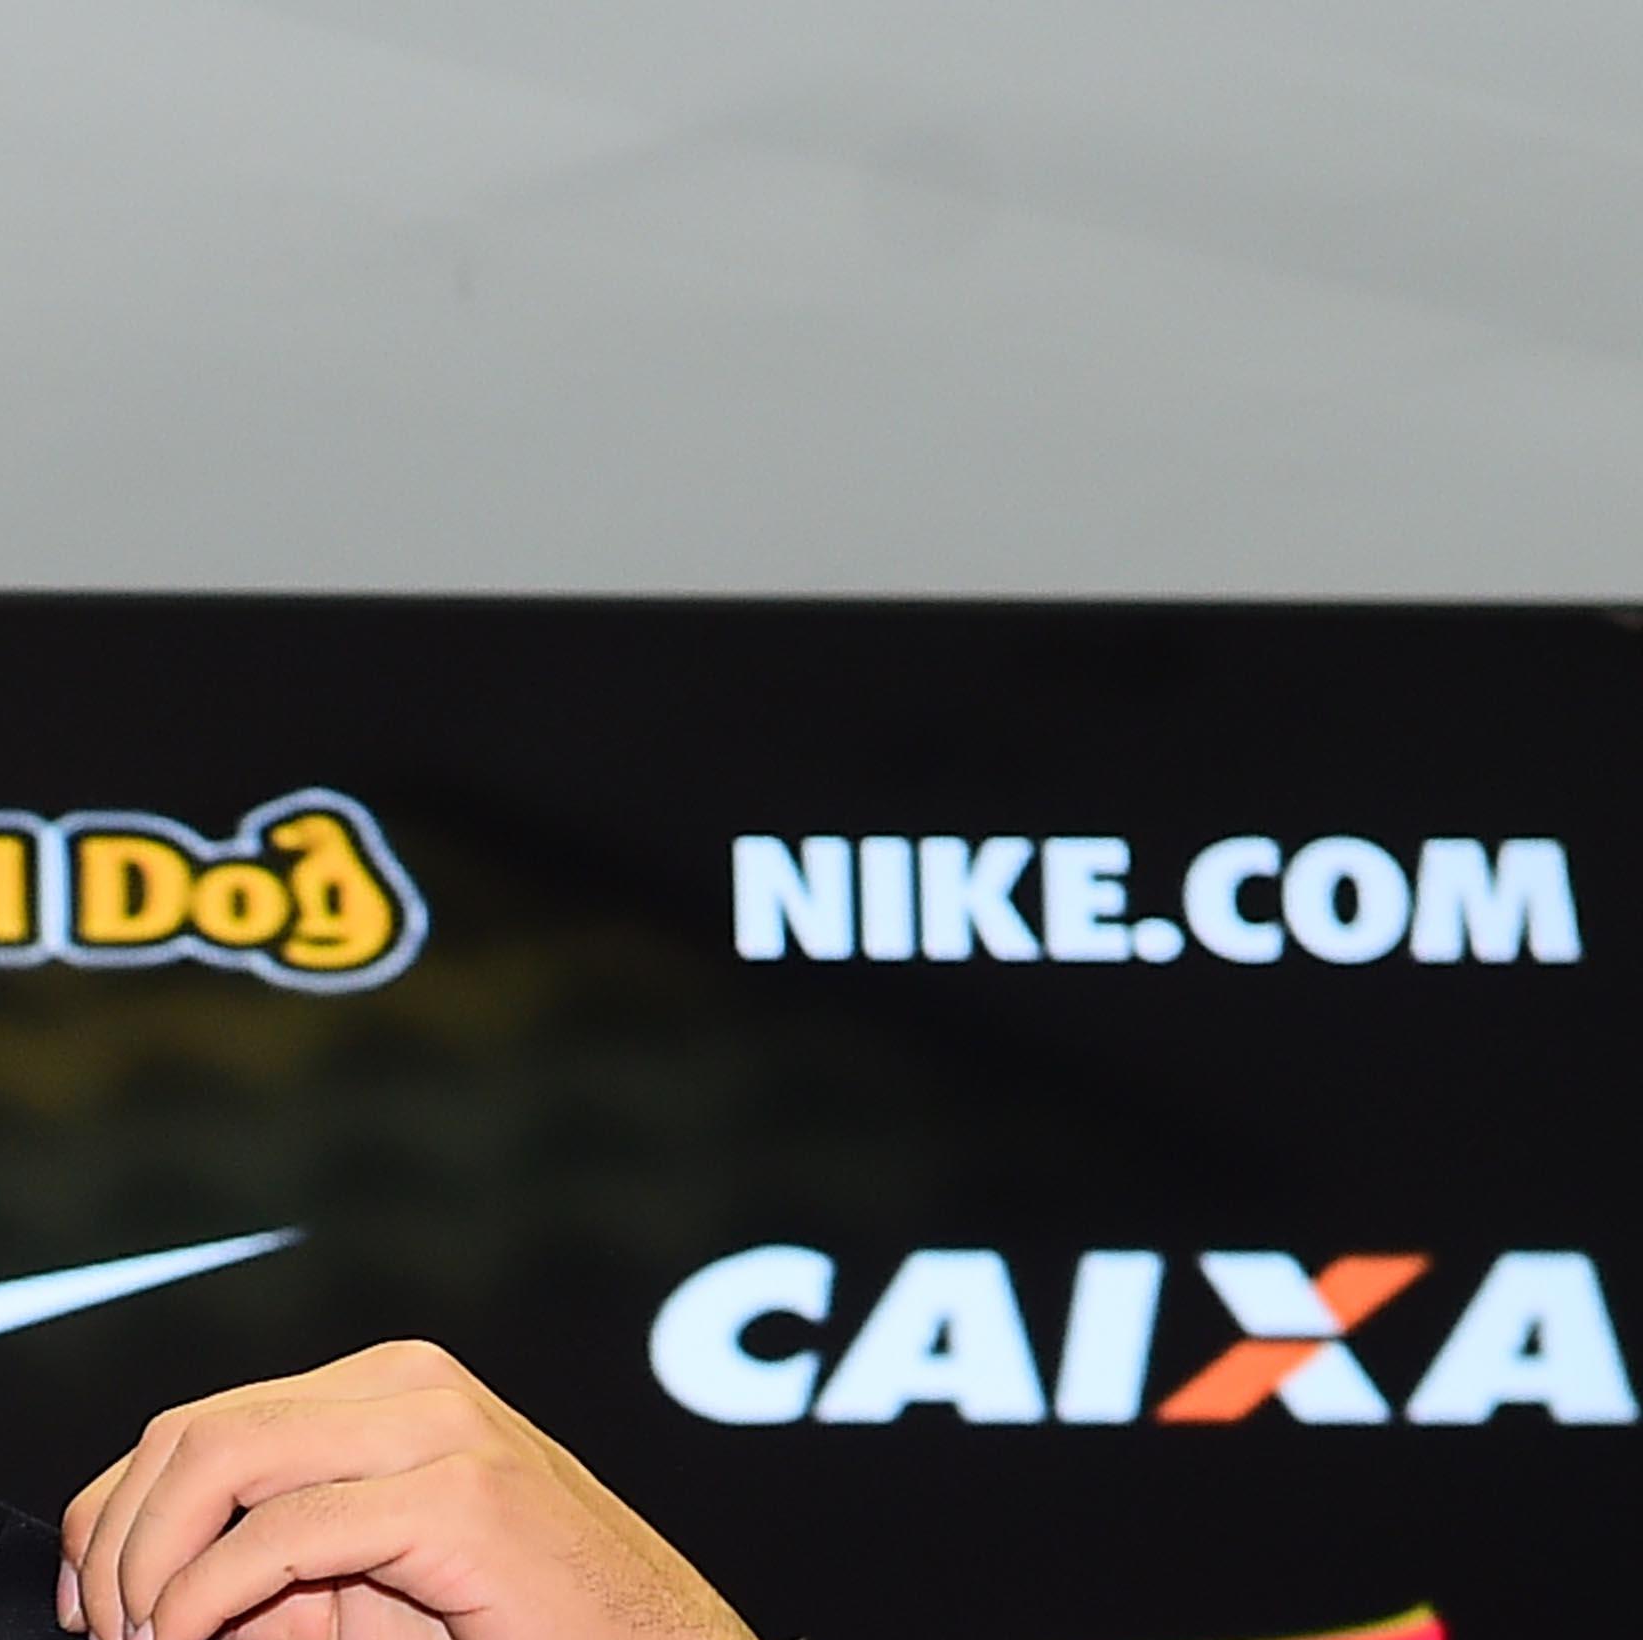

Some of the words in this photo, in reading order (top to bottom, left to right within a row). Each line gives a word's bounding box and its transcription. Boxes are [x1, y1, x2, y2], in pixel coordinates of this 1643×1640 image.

[80, 813, 394, 969] Dog
[731, 833, 1584, 965] NIKE.COM
[648, 1244, 1641, 1426] CAIXA
